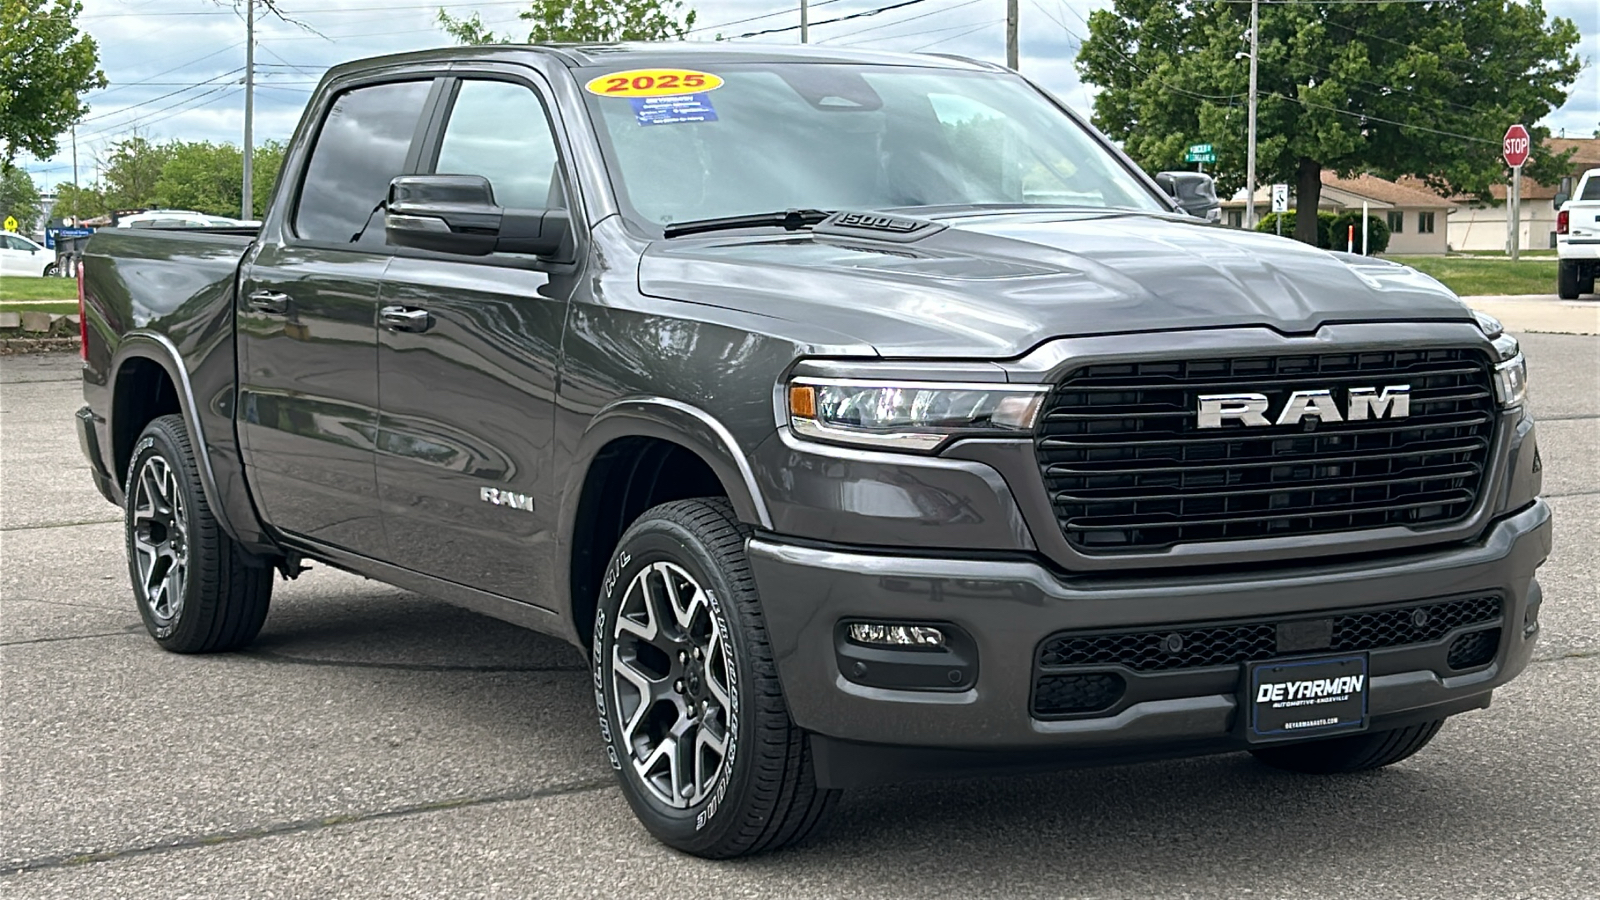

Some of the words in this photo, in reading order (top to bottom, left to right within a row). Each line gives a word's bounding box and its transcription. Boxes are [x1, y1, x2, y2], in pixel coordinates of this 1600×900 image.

[604, 75, 706, 93] 2025
[1505, 138, 1527, 154] STOP
[839, 212, 892, 228] 1500
[1197, 385, 1411, 429] RAM
[480, 486, 534, 513] RAM
[593, 609, 622, 770] DUELER
[1256, 674, 1364, 702] DEYARMAN
[696, 589, 740, 831] BRIDGESTONE
[1285, 717, 1339, 730] DEYARMANAUTO.COM
